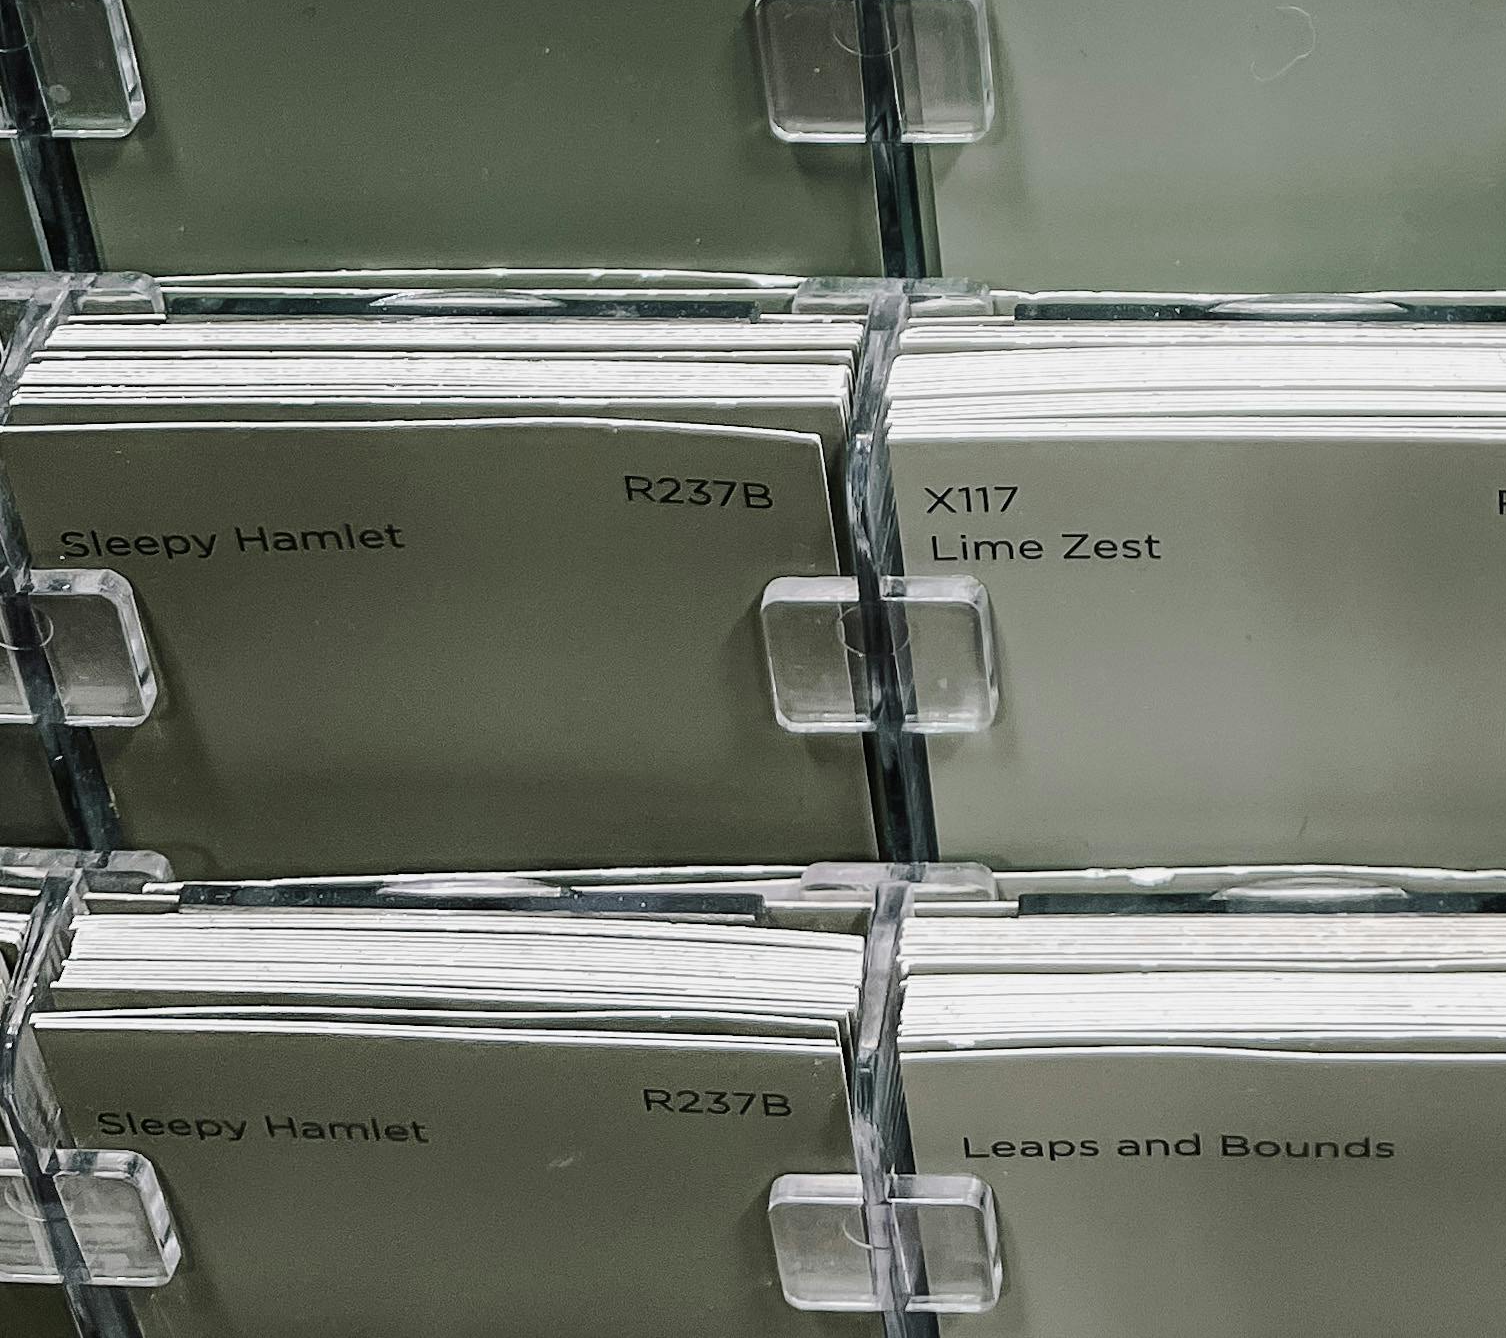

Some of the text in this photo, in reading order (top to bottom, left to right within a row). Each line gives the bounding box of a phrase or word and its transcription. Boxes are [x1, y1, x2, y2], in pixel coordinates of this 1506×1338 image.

[624, 475, 773, 510] R237B
[925, 486, 1018, 514] X117
[60, 523, 405, 560] Sleepy Hamlet
[931, 533, 1161, 561] Lime Zest
[643, 1088, 792, 1117] R237B
[97, 1111, 429, 1143] Sleepy Hamlet
[963, 1133, 1395, 1162] Leaps and Bounds
